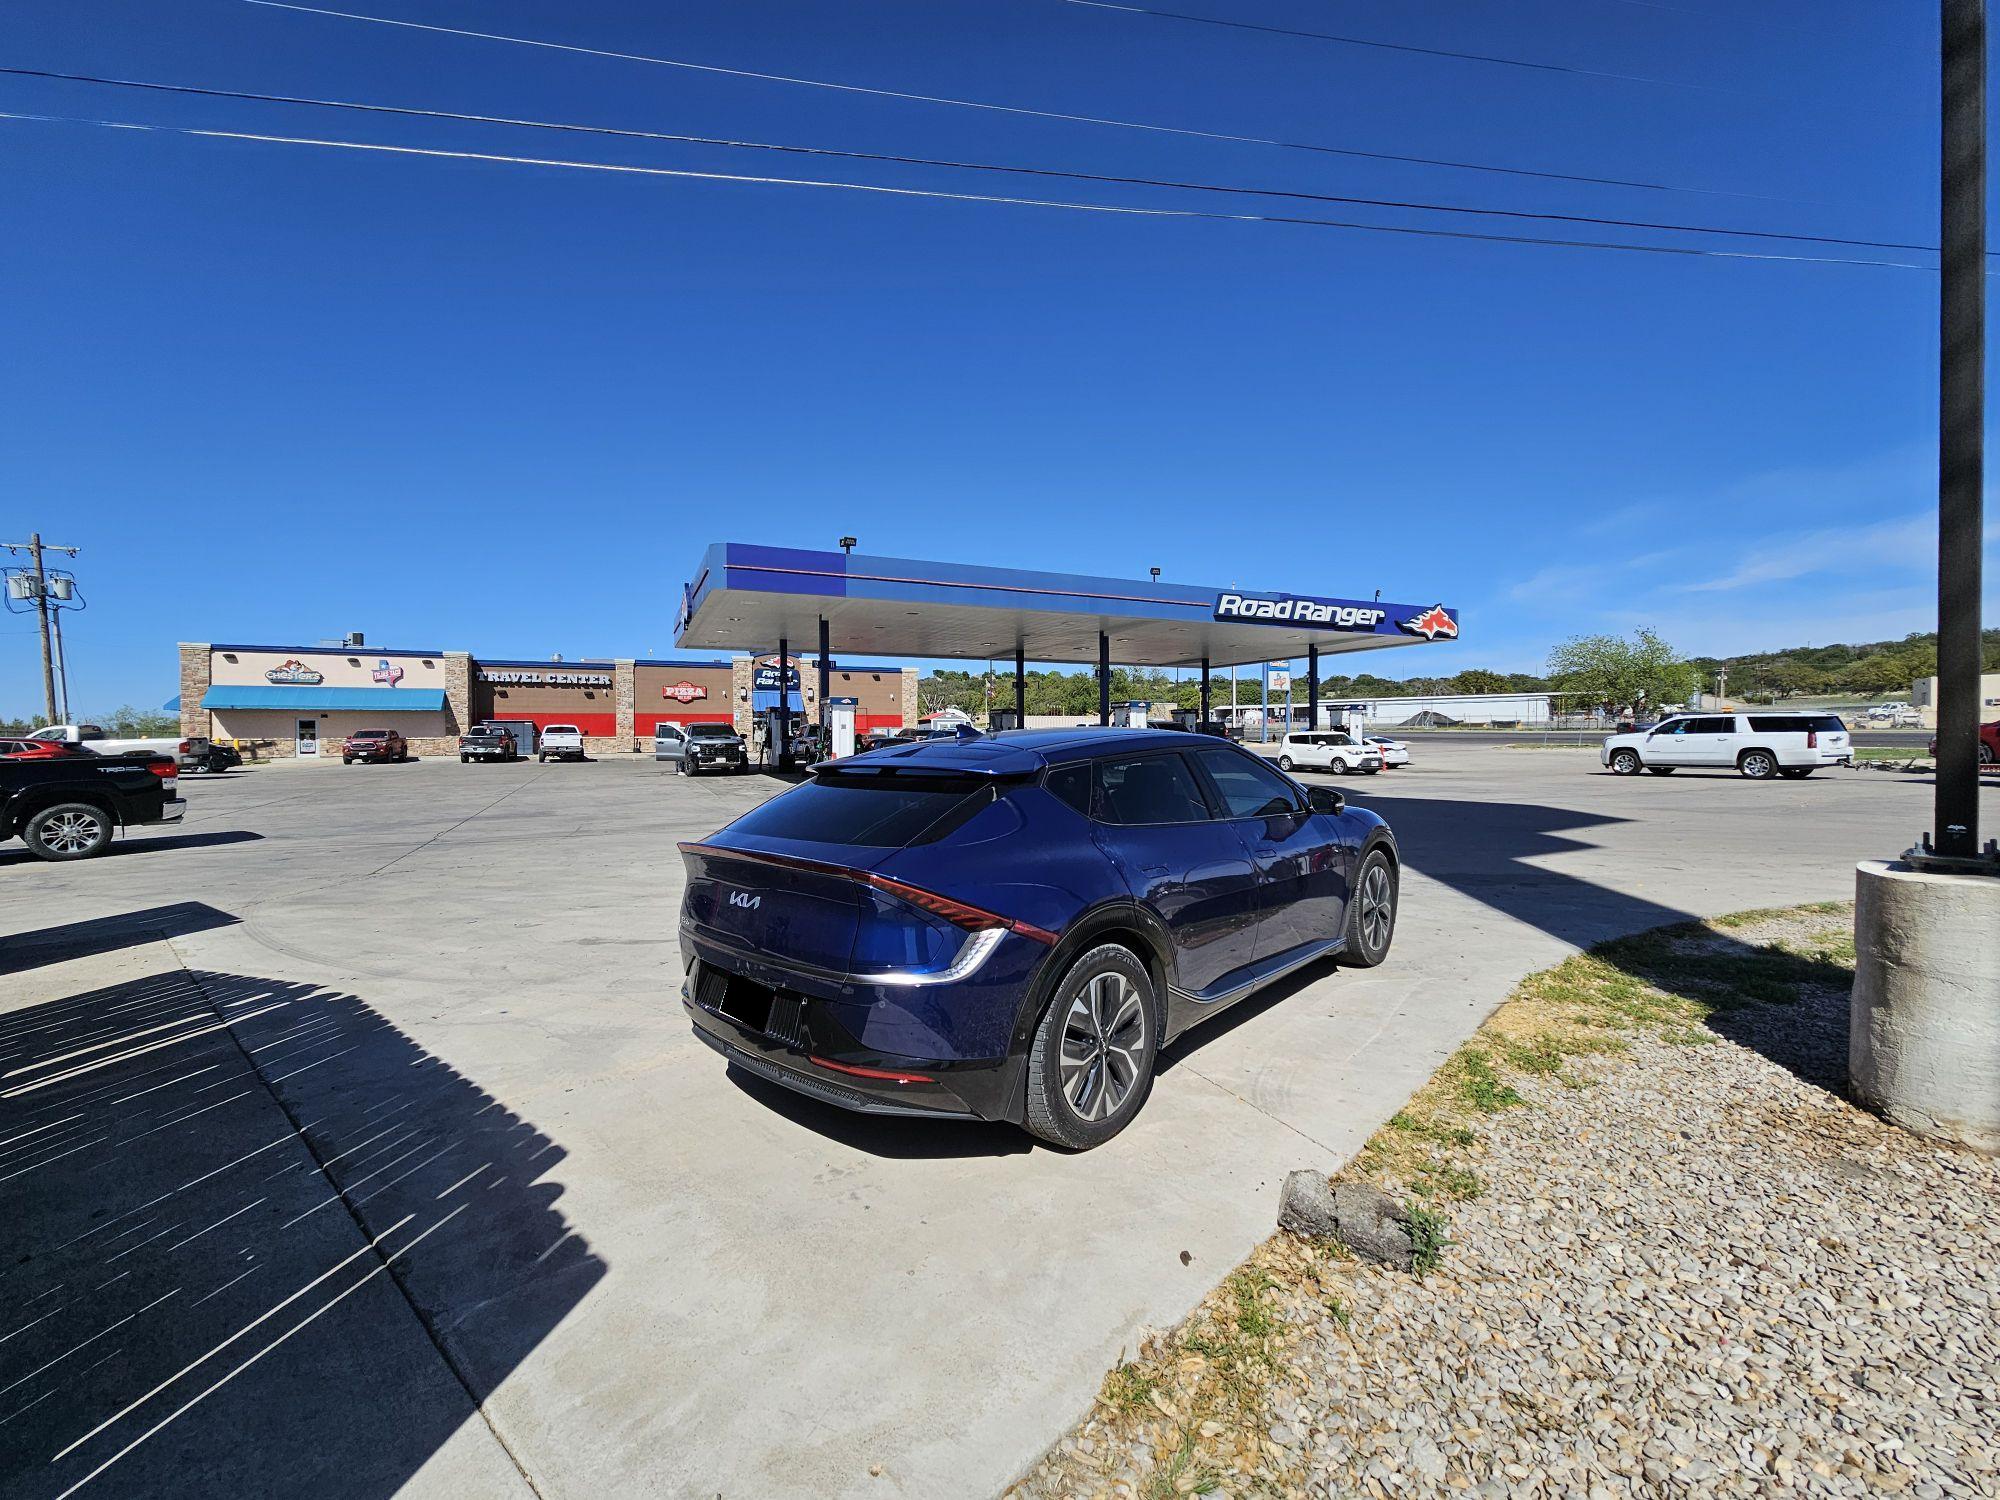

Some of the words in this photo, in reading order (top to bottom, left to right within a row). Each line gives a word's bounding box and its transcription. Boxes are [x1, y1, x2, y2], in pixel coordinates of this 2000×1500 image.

[1218, 594, 1293, 619] Road
[1294, 601, 1386, 626] Ranger
[476, 671, 541, 682] TRAVEL
[545, 672, 611, 685] CENTER
[665, 687, 704, 697] PIZZA
[729, 890, 761, 910] KIA
